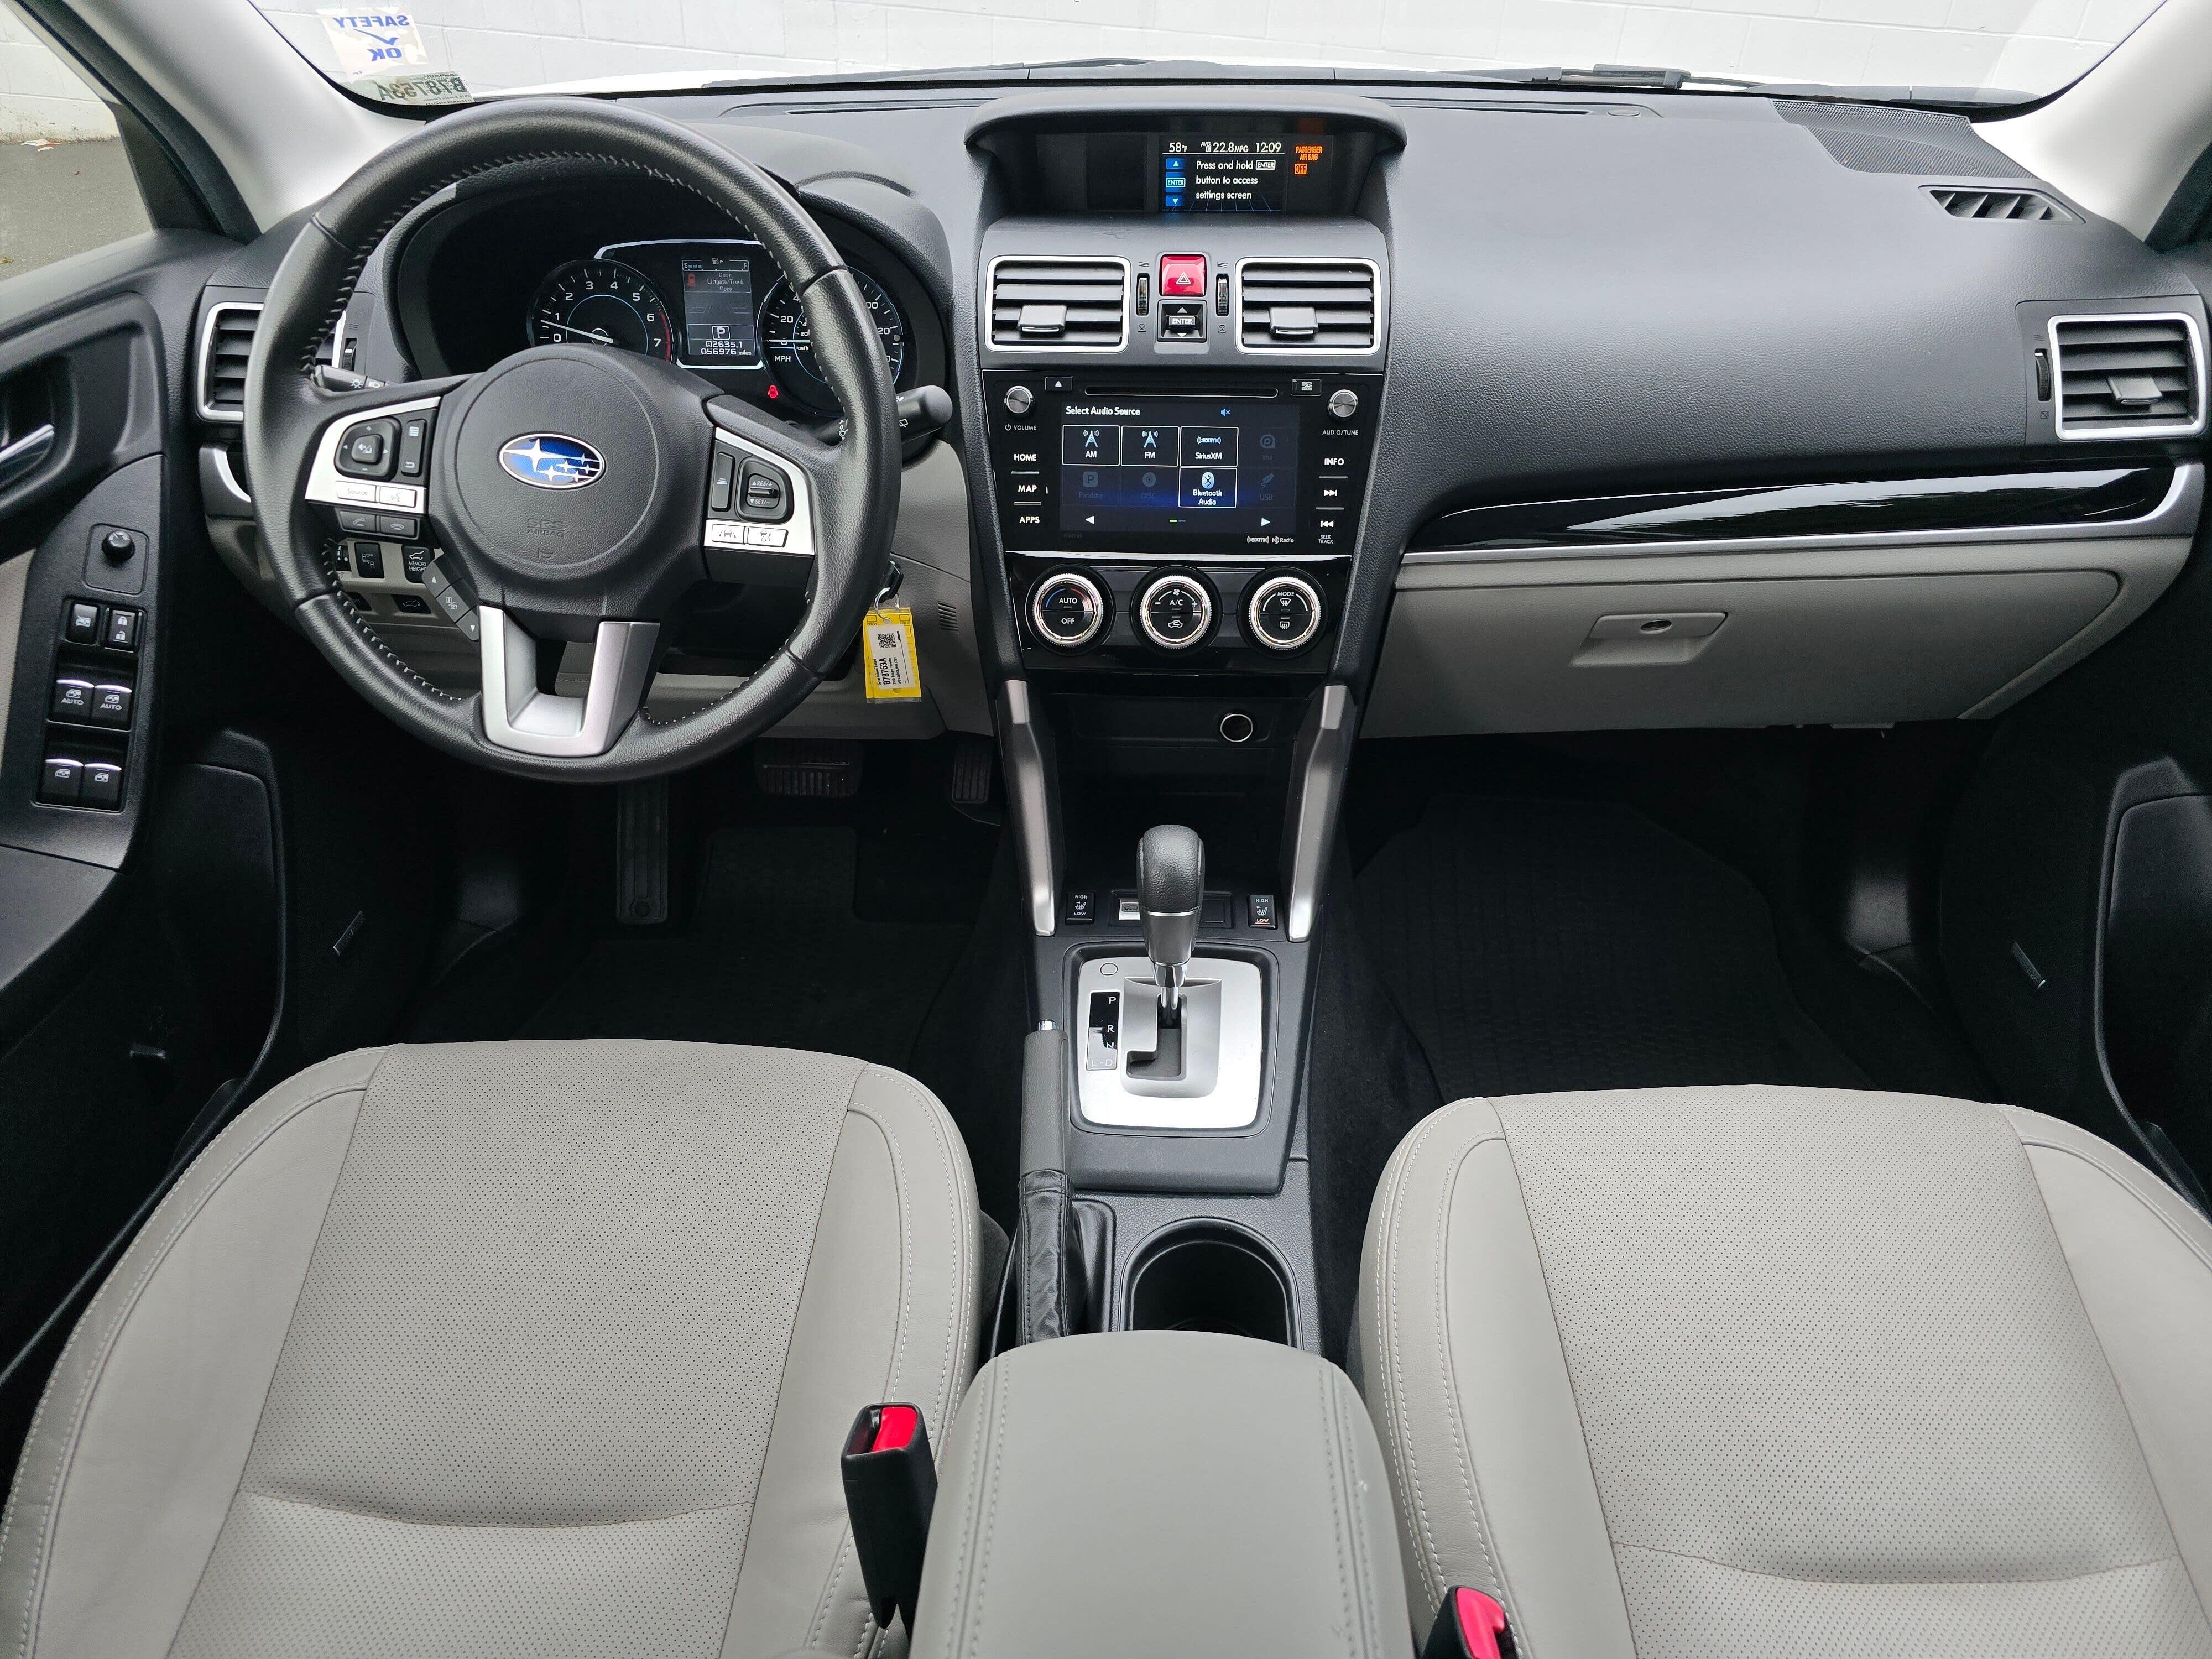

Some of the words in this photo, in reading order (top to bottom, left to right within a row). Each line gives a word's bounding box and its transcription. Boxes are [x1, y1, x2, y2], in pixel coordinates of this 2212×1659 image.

[1255, 142, 1282, 153] 12:09
[1295, 145, 1322, 154] PASSENGER
[1196, 160, 1216, 169] Press
[1218, 160, 1234, 169] and
[1235, 160, 1254, 169] hold
[1196, 176, 1220, 185] button
[1196, 190, 1224, 201] settings
[586, 281, 593, 290] 3
[610, 281, 618, 290] 4
[565, 292, 573, 301] 2
[632, 293, 640, 301] 5
[555, 312, 560, 321] 1
[646, 313, 655, 322] 6
[717, 327, 726, 338] P
[553, 333, 561, 342] 0
[654, 338, 662, 347] 7
[1066, 406, 1089, 415] Select
[1091, 406, 1113, 415] Audio
[1114, 407, 1140, 415] Source
[1018, 484, 1037, 493] MAP
[878, 658, 891, 685] B78753A
[1107, 1024, 1115, 1033] R
[1107, 1041, 1114, 1050] N
